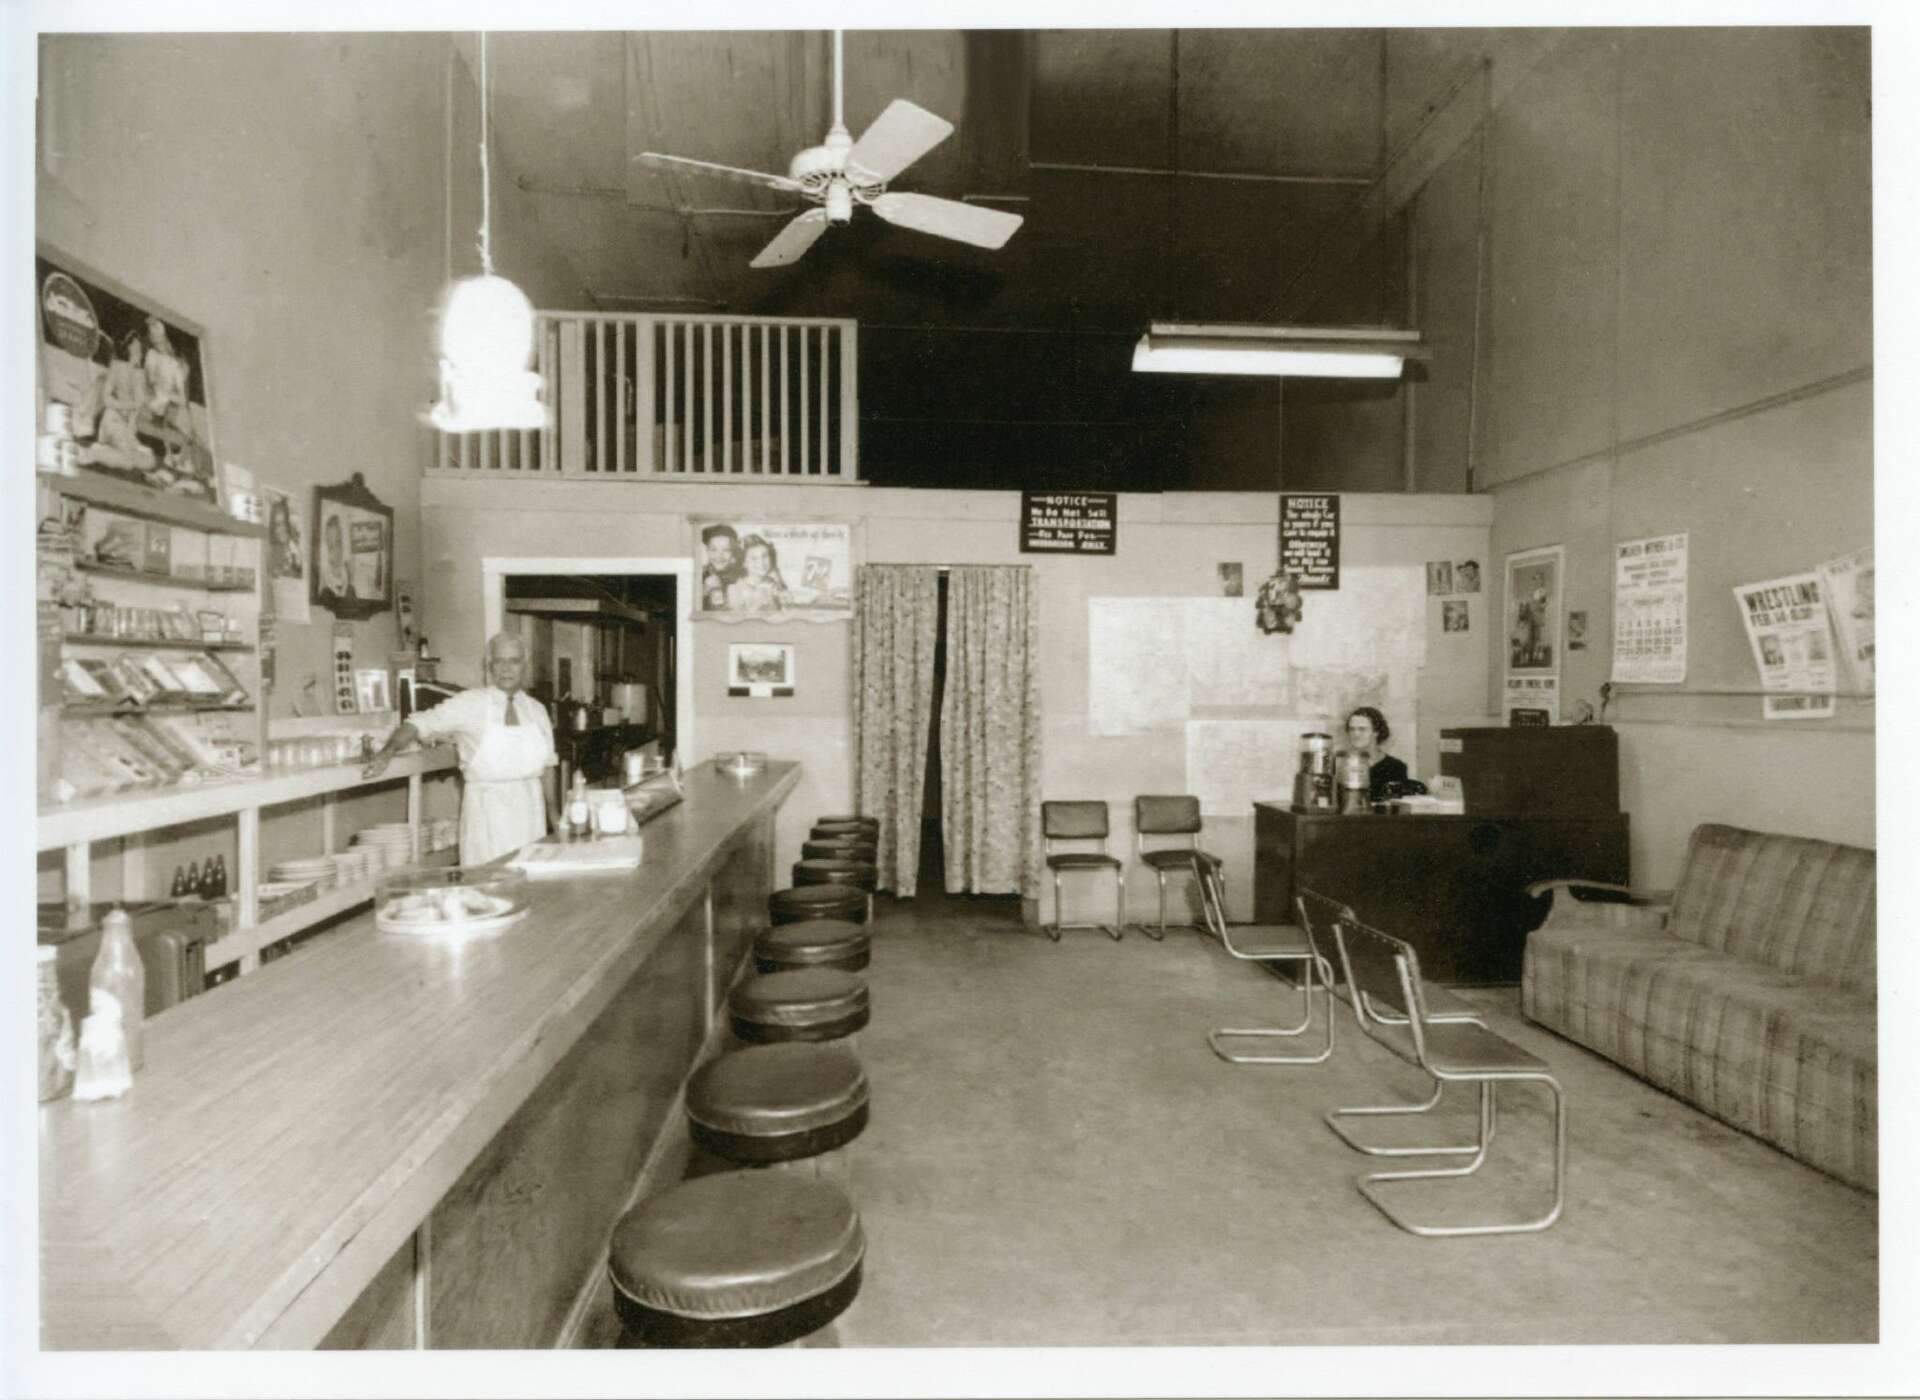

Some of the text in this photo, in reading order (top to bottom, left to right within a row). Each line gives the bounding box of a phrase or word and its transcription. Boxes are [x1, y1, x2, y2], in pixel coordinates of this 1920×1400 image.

[1046, 496, 1087, 506] NOTICE
[1288, 498, 1329, 509] NOTICE
[1031, 517, 1111, 529] TRANSPORTATION
[1743, 582, 1820, 613] WRESTLING
